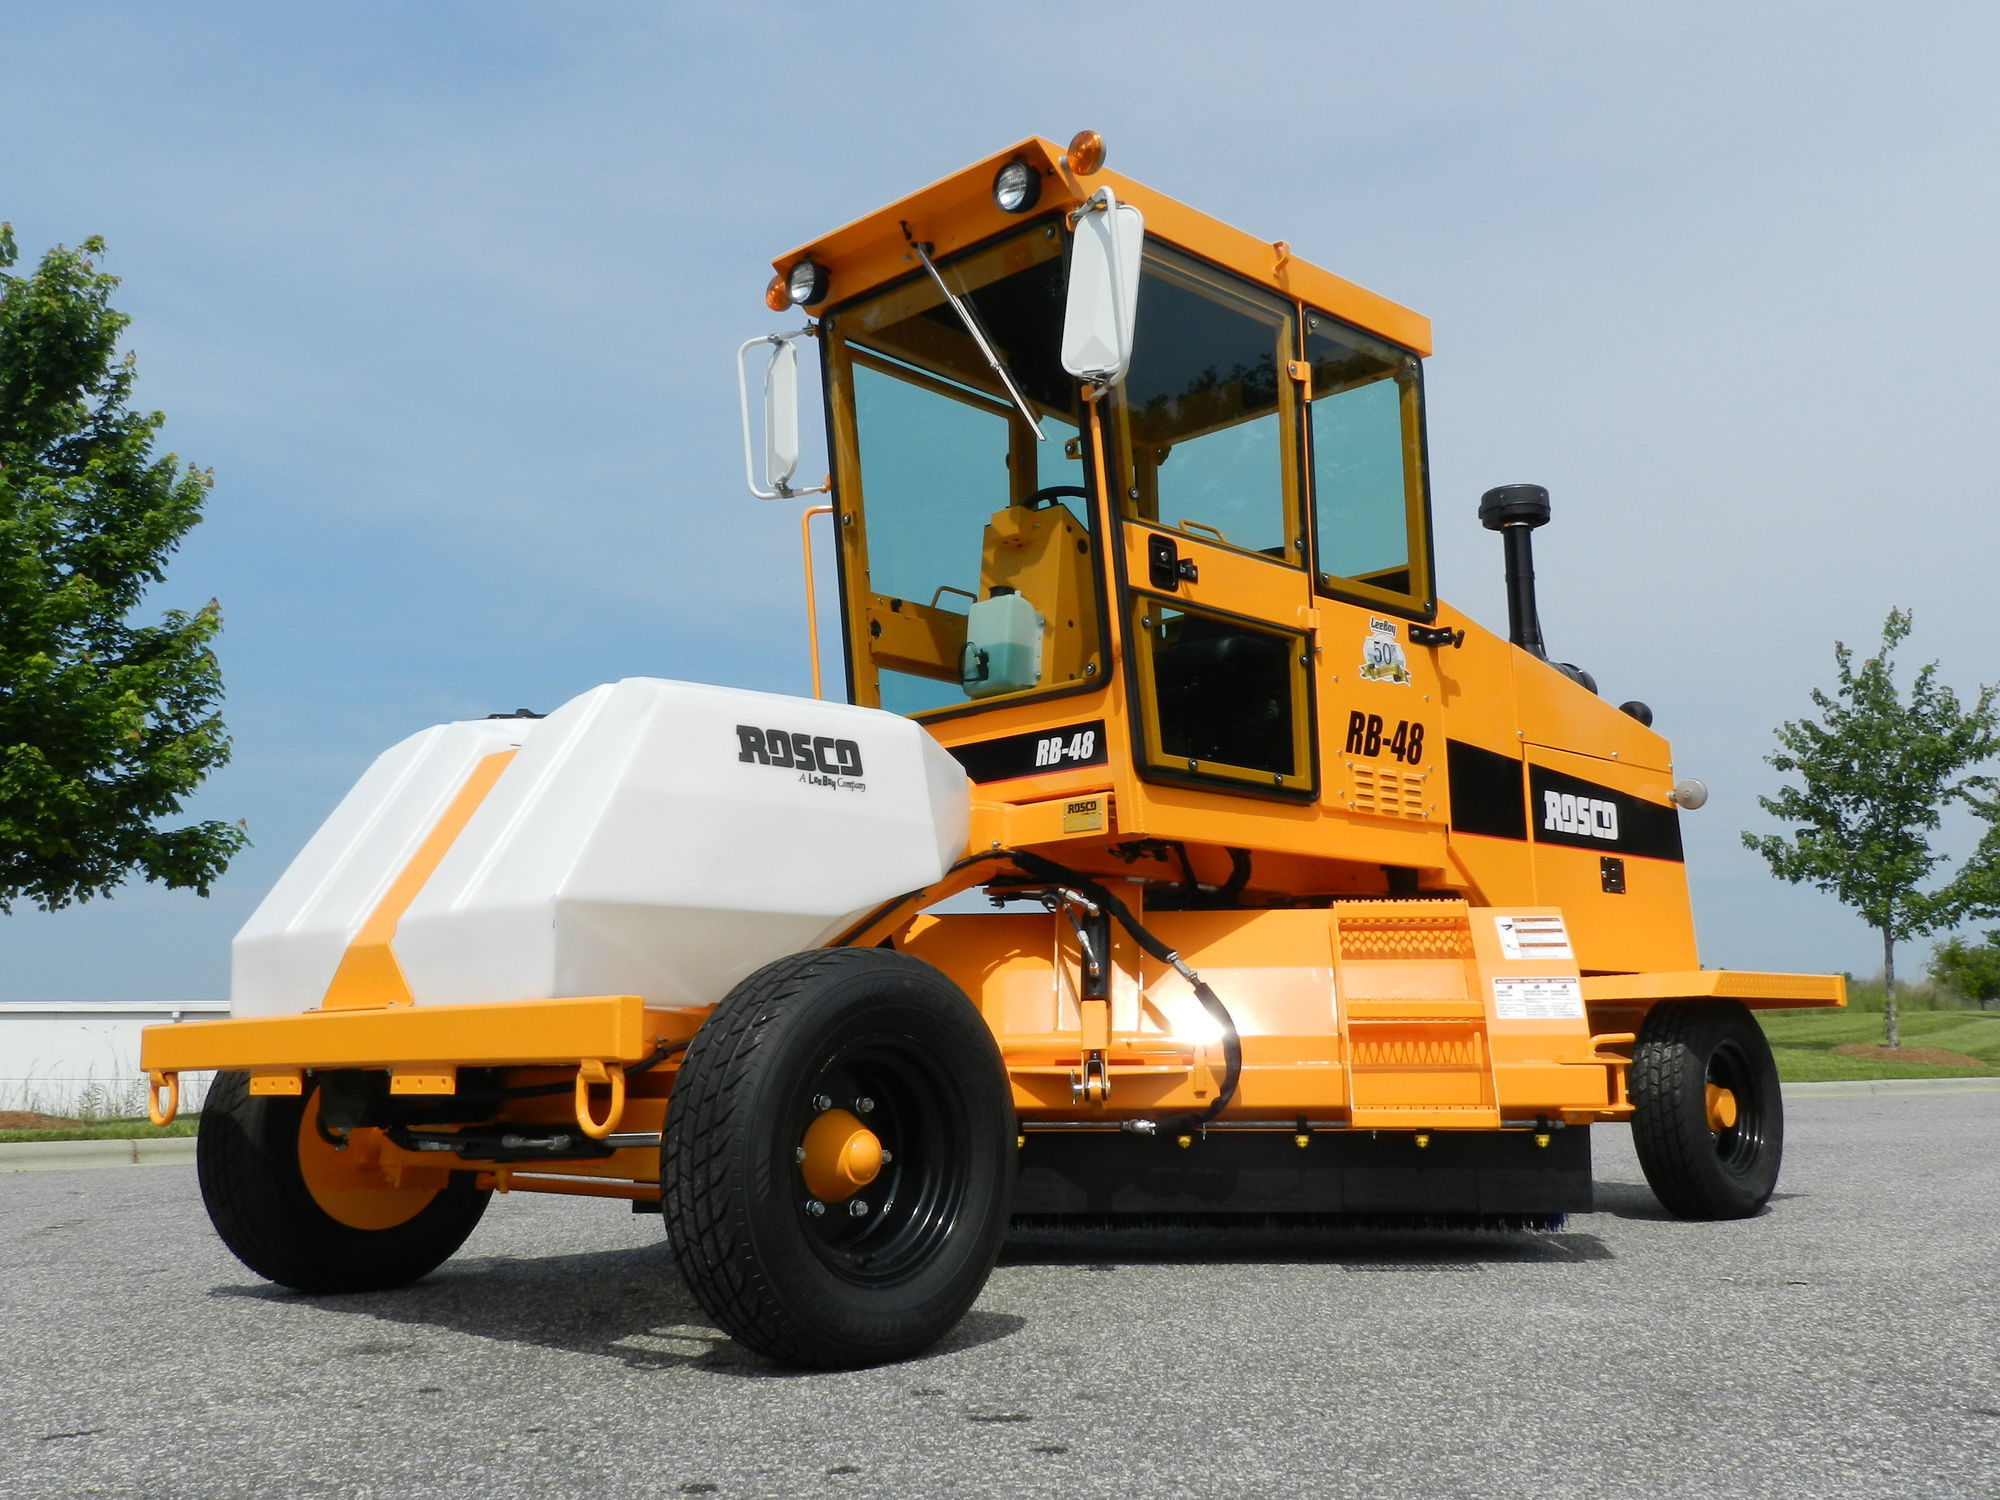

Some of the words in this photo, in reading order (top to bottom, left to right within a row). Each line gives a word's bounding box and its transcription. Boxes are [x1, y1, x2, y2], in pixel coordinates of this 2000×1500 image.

[1371, 617, 1396, 636] LeeBoy
[736, 725, 864, 777] ROSCO
[1035, 731, 1095, 767] RB-48
[1345, 710, 1424, 765] RB-48
[798, 773, 806, 783] A
[837, 777, 866, 793] Company
[1067, 801, 1097, 814] ROSCO
[1544, 790, 1618, 840] ROSCO
